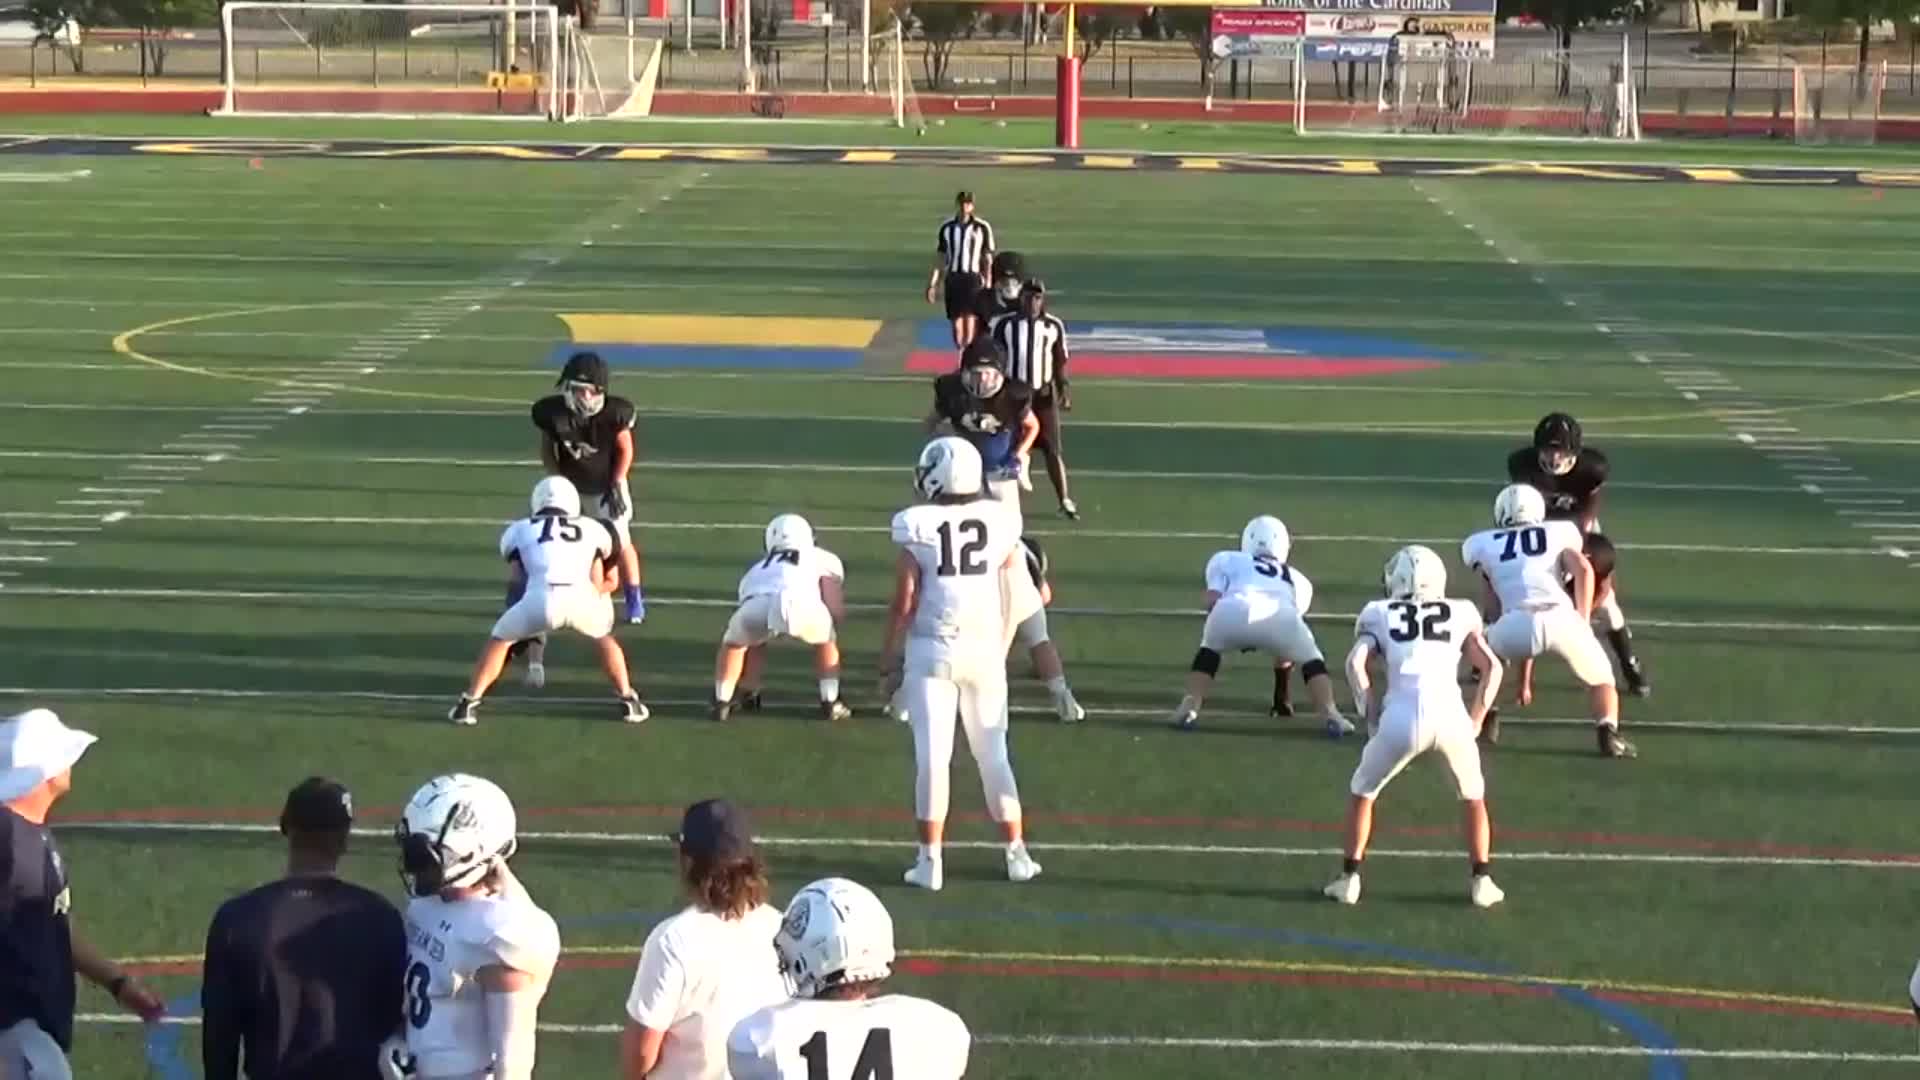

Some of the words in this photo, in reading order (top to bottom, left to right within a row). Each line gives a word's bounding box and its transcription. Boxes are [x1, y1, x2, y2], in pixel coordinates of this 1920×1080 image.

[535, 517, 582, 543] 75
[937, 519, 988, 576] 12
[1494, 527, 1547, 562] 70
[1388, 602, 1451, 642] 32
[799, 1027, 894, 1080] 14
